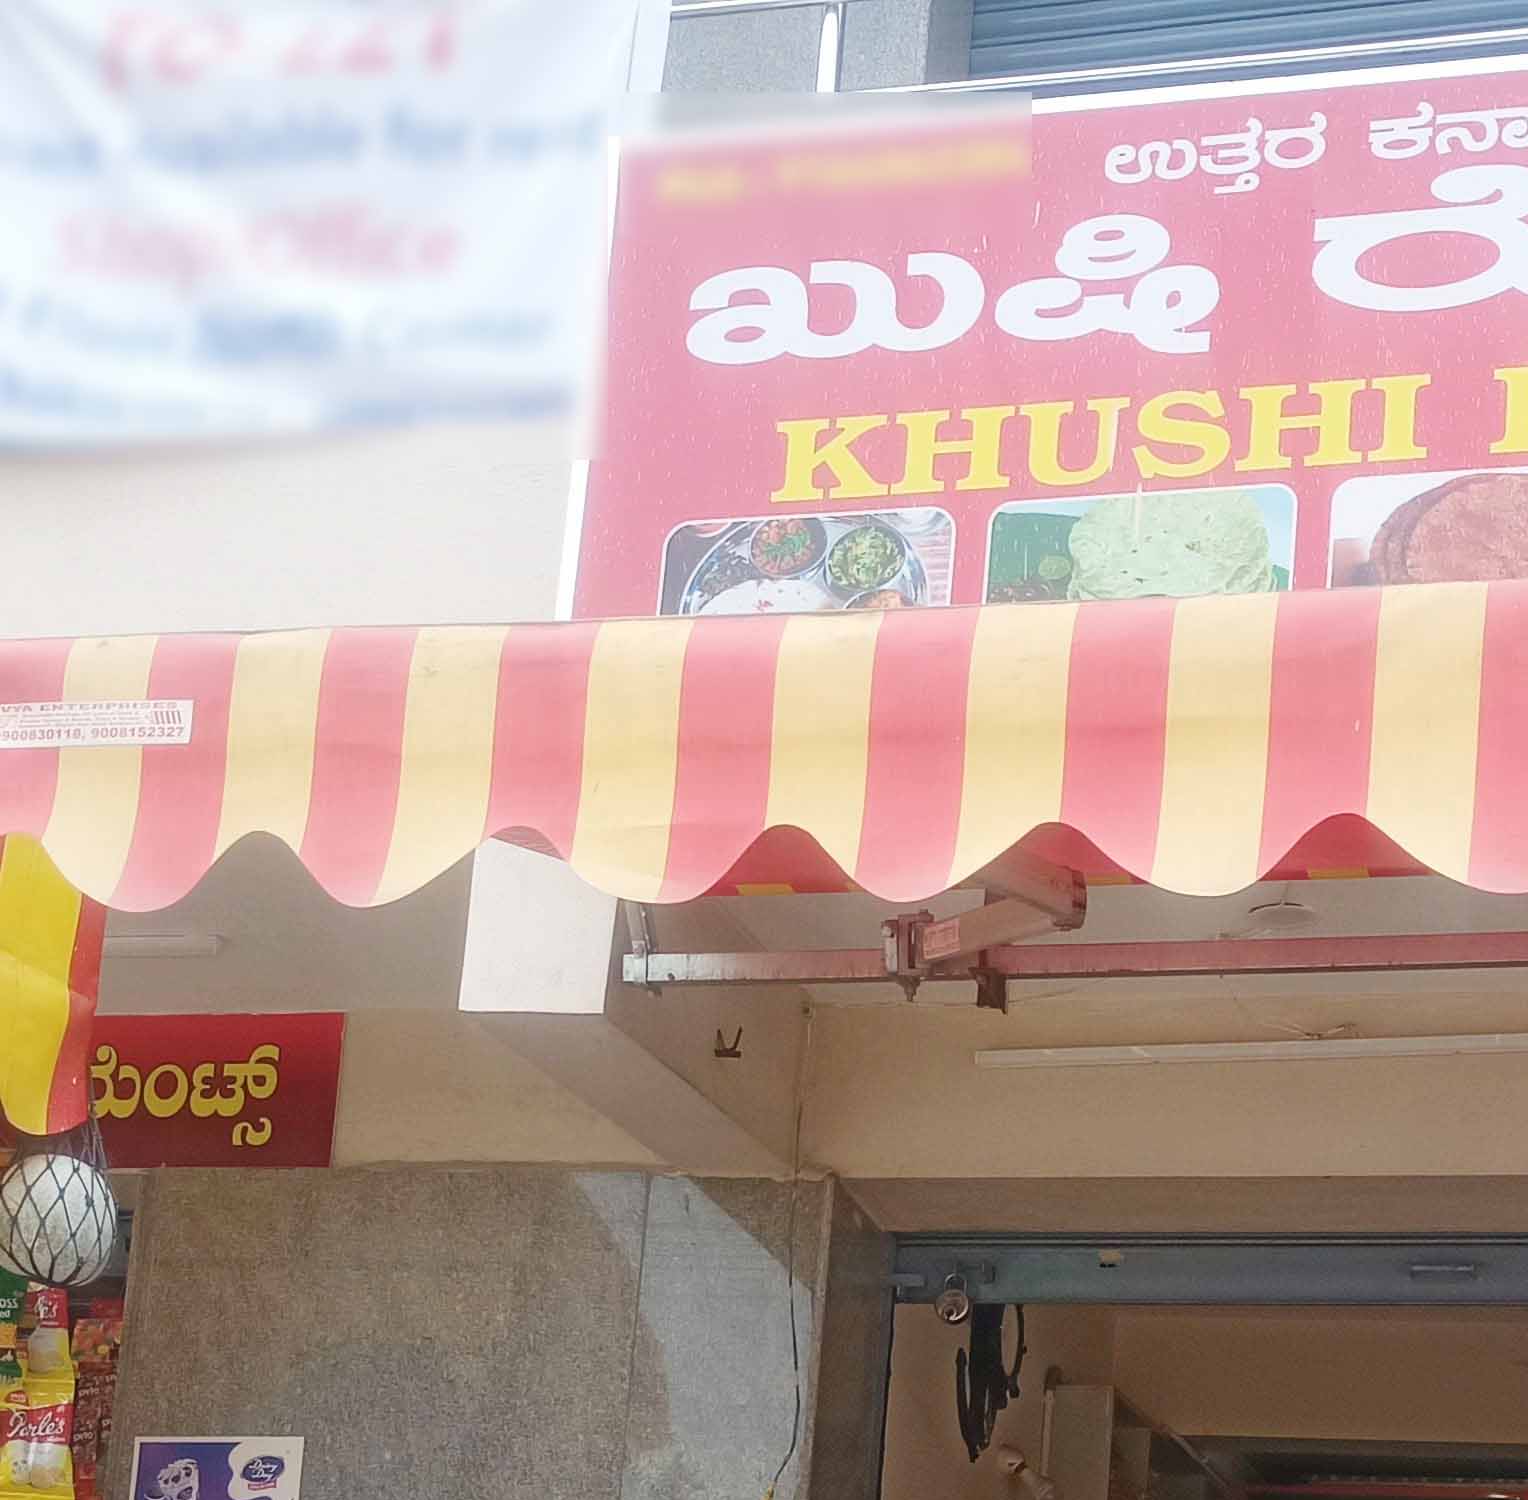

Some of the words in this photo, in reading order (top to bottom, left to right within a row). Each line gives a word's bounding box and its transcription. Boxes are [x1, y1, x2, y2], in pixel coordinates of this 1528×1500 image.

[1103, 111, 1328, 195] ಉತ್ತರ
[685, 213, 1221, 365] ಖುಷಿ
[773, 374, 1427, 503] KHUSHI
